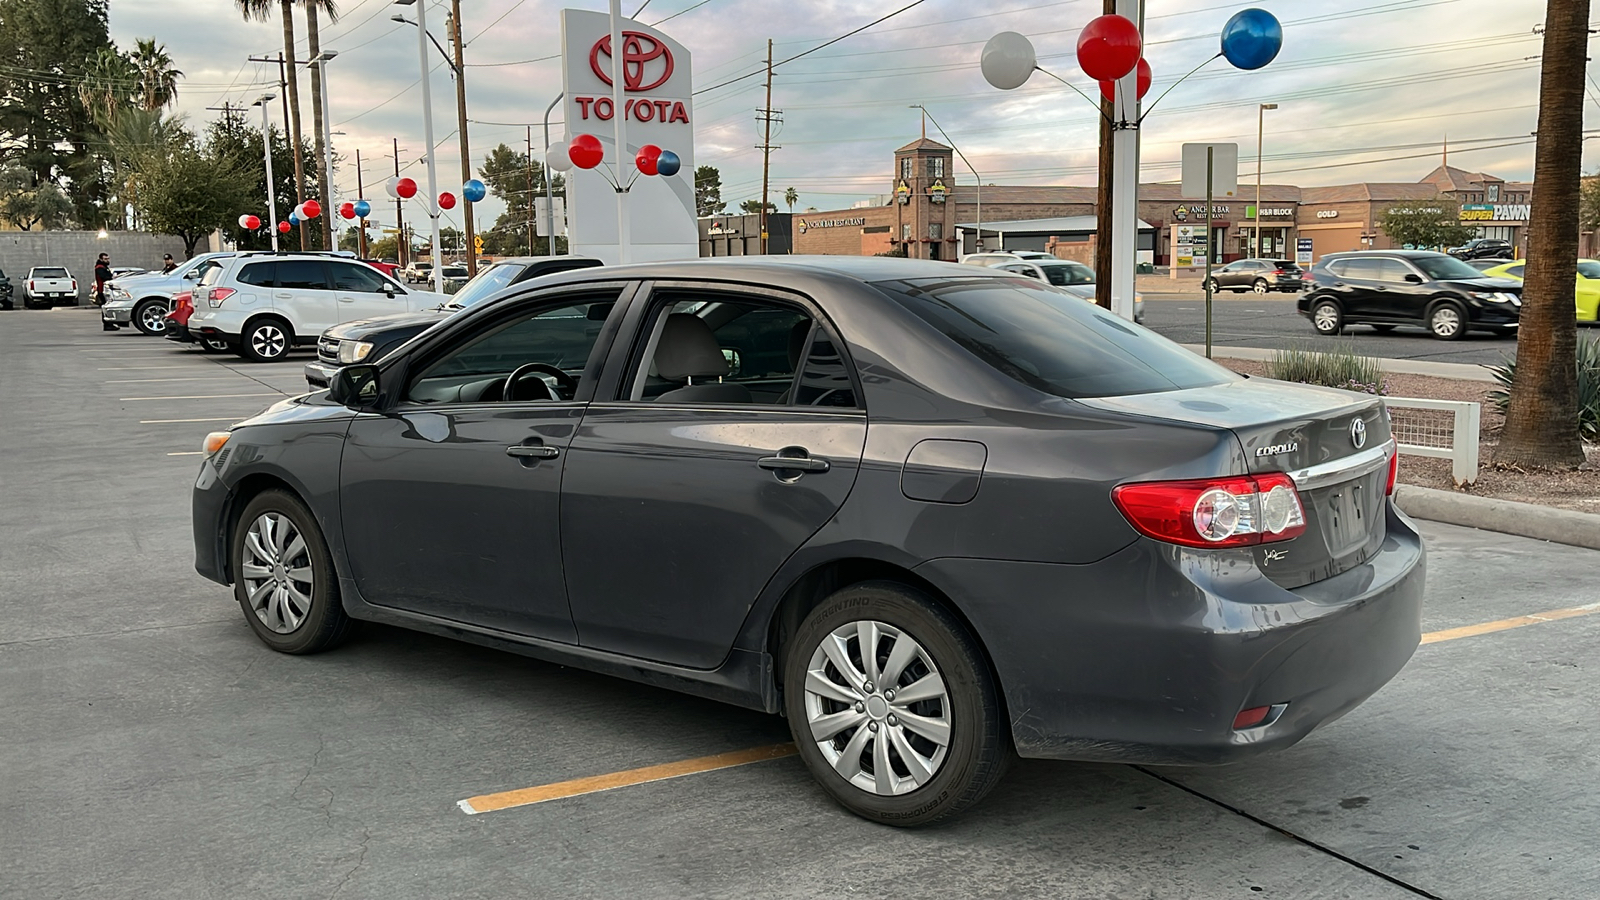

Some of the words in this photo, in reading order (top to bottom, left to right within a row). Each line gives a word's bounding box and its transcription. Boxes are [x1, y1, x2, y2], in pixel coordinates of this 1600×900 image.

[1190, 205, 1216, 213] ANCHR
[1217, 205, 1230, 213] BAR
[1259, 208, 1272, 216] H&R
[1273, 208, 1293, 216] BLOCK
[1316, 210, 1338, 218] GOLD
[1459, 210, 1493, 220] SUPER
[1493, 205, 1531, 220] PAWN
[807, 220, 824, 229] ANCHOR
[835, 217, 864, 227] RESTAURANT
[1256, 442, 1298, 457] COROLLA
